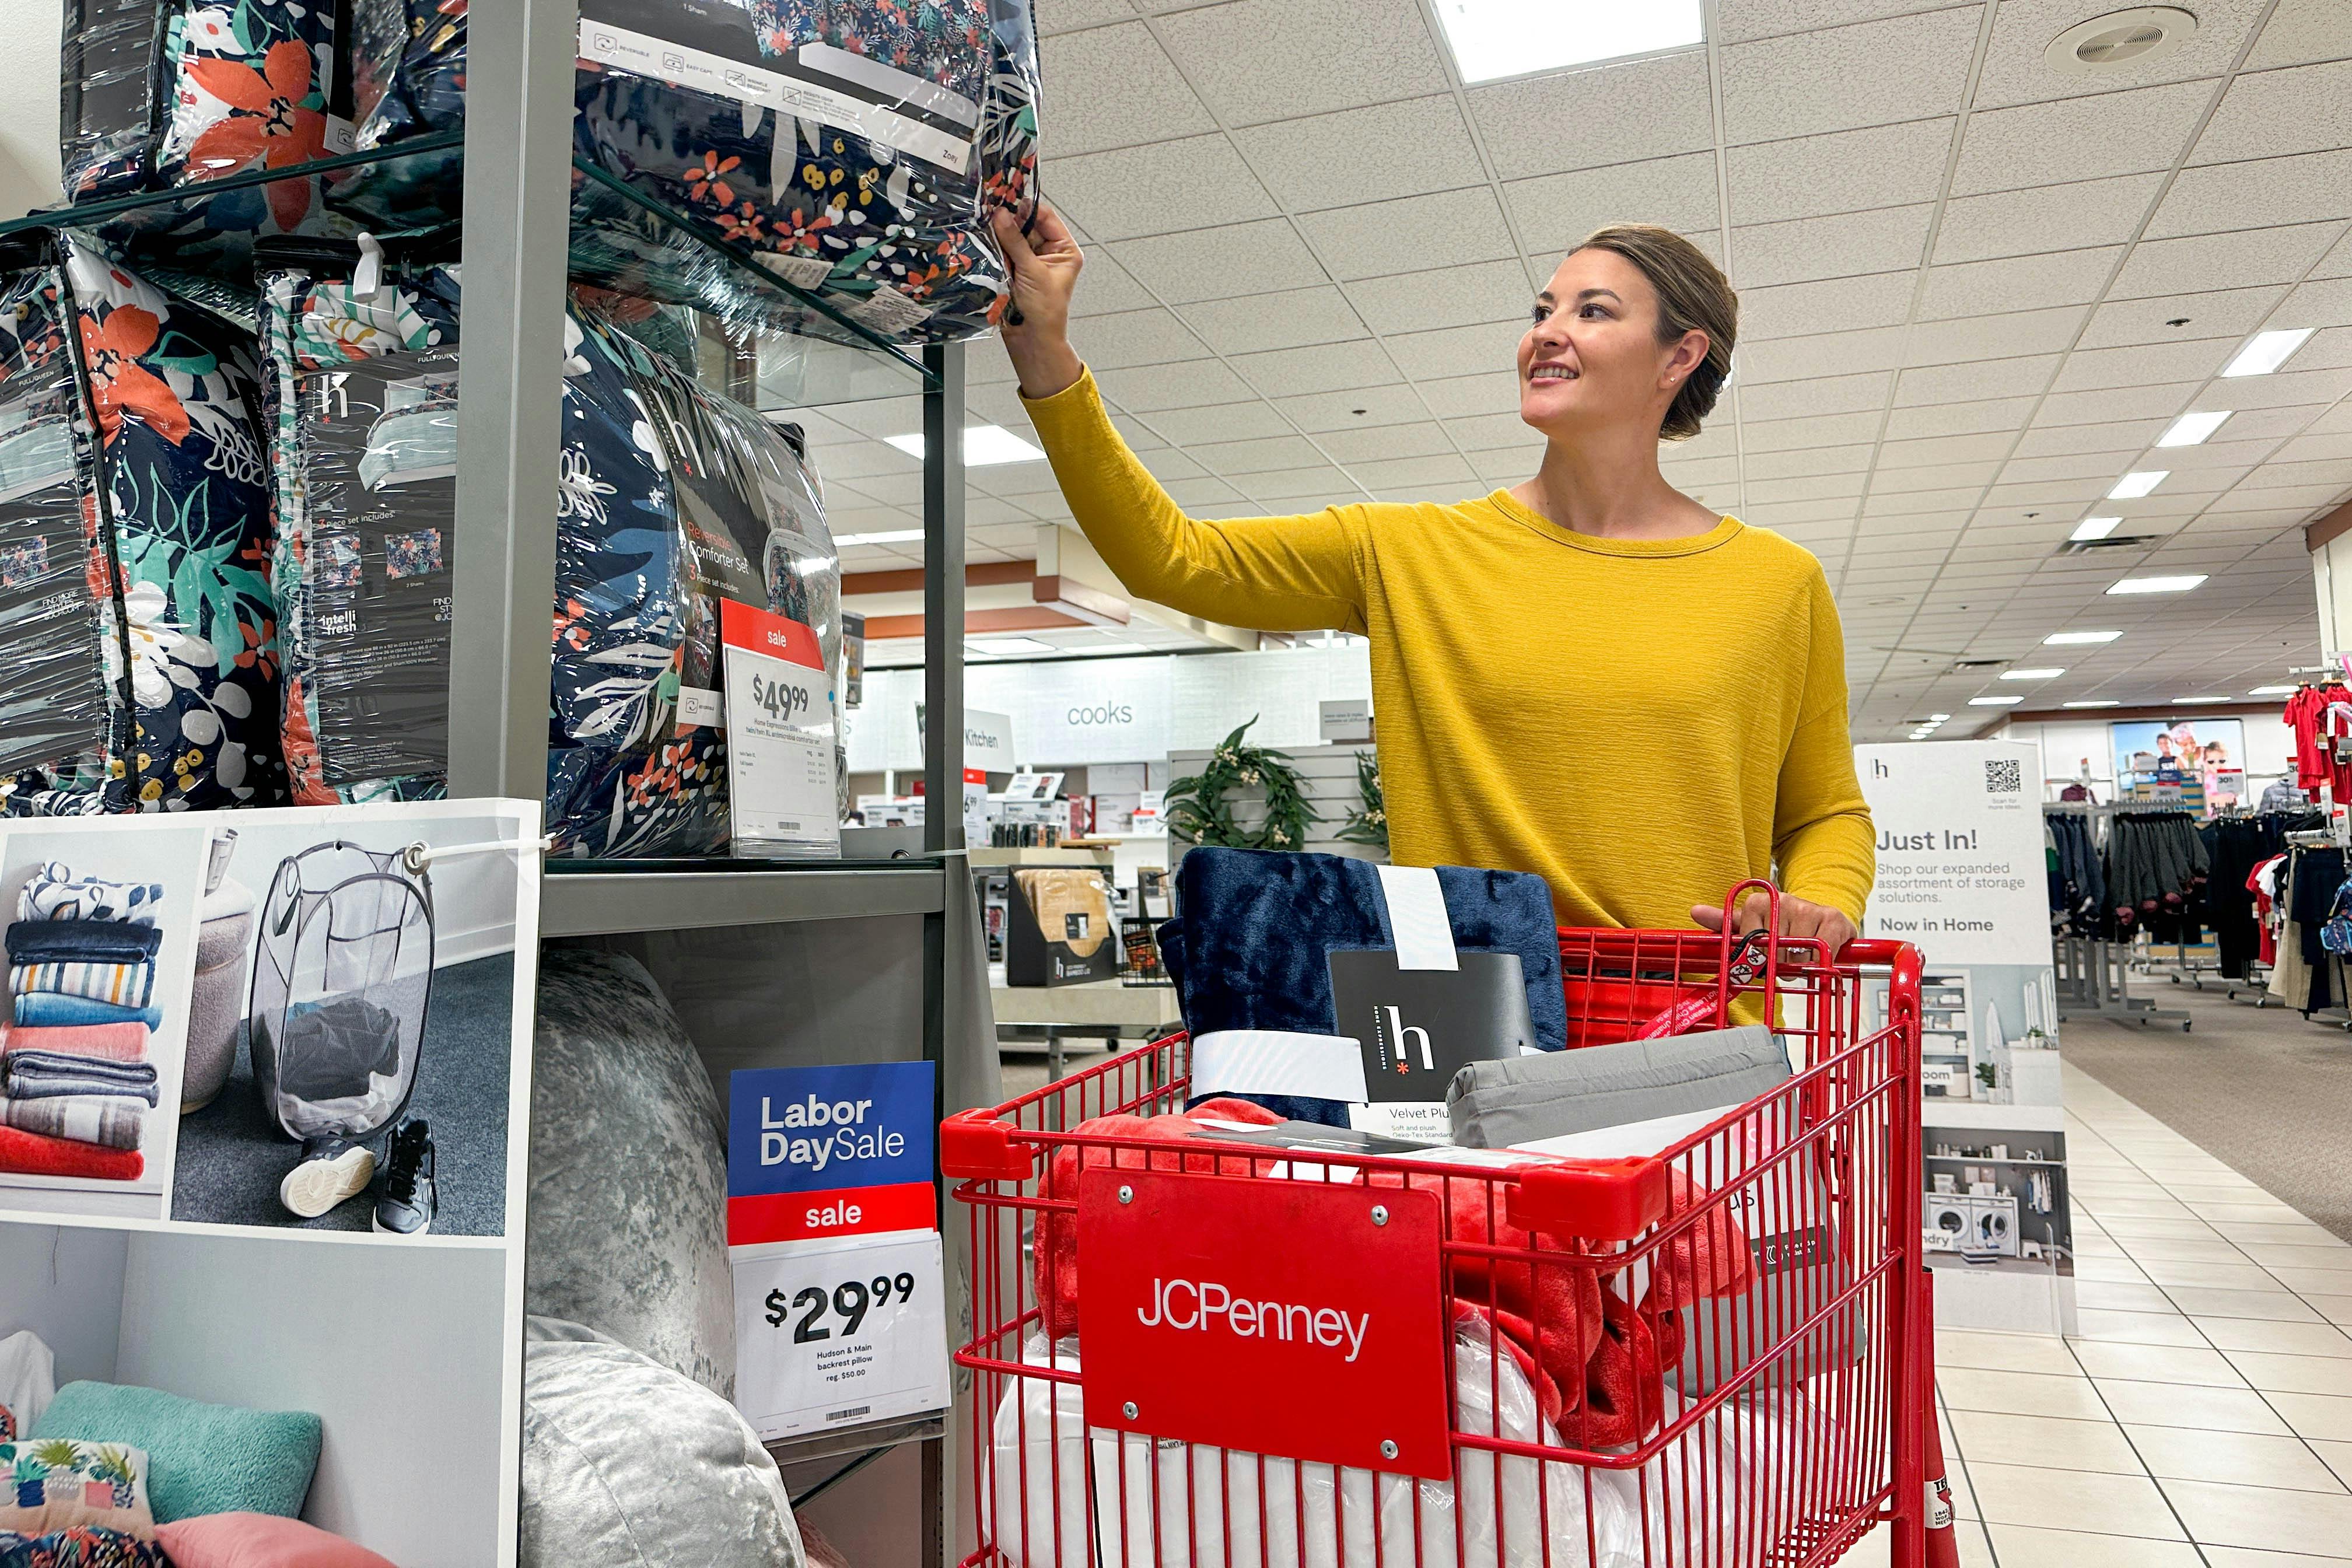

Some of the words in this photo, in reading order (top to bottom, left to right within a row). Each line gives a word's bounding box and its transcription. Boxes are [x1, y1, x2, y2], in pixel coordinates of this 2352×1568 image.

[688, 5, 707, 15] Sham
[943, 149, 958, 164] Zoey
[19, 370, 54, 387] FULL/QUEEN
[687, 522, 732, 551] Reversible
[689, 540, 734, 569] Comforter
[736, 557, 750, 575] Set
[690, 564, 695, 580] 3
[43, 598, 57, 607] FIND
[433, 597, 452, 606] FIND
[321, 611, 356, 626] intelli
[327, 623, 356, 635] fresh
[768, 629, 786, 647] sale
[1068, 701, 1132, 725] cooks
[965, 729, 999, 749] Kitchen
[1877, 830, 1935, 850] Just
[1945, 830, 1978, 850] In!
[1877, 863, 1912, 876] Shop
[1916, 864, 1938, 874] our
[1943, 862, 2010, 876] expanded
[1878, 878, 1952, 889] assortment
[1957, 877, 1971, 888] of
[1975, 878, 2025, 891] storage
[1879, 892, 1941, 903] solutions.
[1881, 918, 1918, 931] Now
[1923, 918, 1938, 930] in
[1944, 918, 1994, 931] Home
[1384, 1006, 1434, 1069] h
[761, 1094, 872, 1129] Labor
[1389, 1108, 1427, 1118] Velvet
[806, 1199, 862, 1228] sale
[1138, 1278, 1369, 1362] JCPenney
[817, 1348, 845, 1359] Hudson
[854, 1343, 872, 1352] Main
[817, 1359, 850, 1371] backrest
[852, 1355, 873, 1367] pillow
[826, 1374, 840, 1382] reg.
[842, 1369, 866, 1379] $50.00
